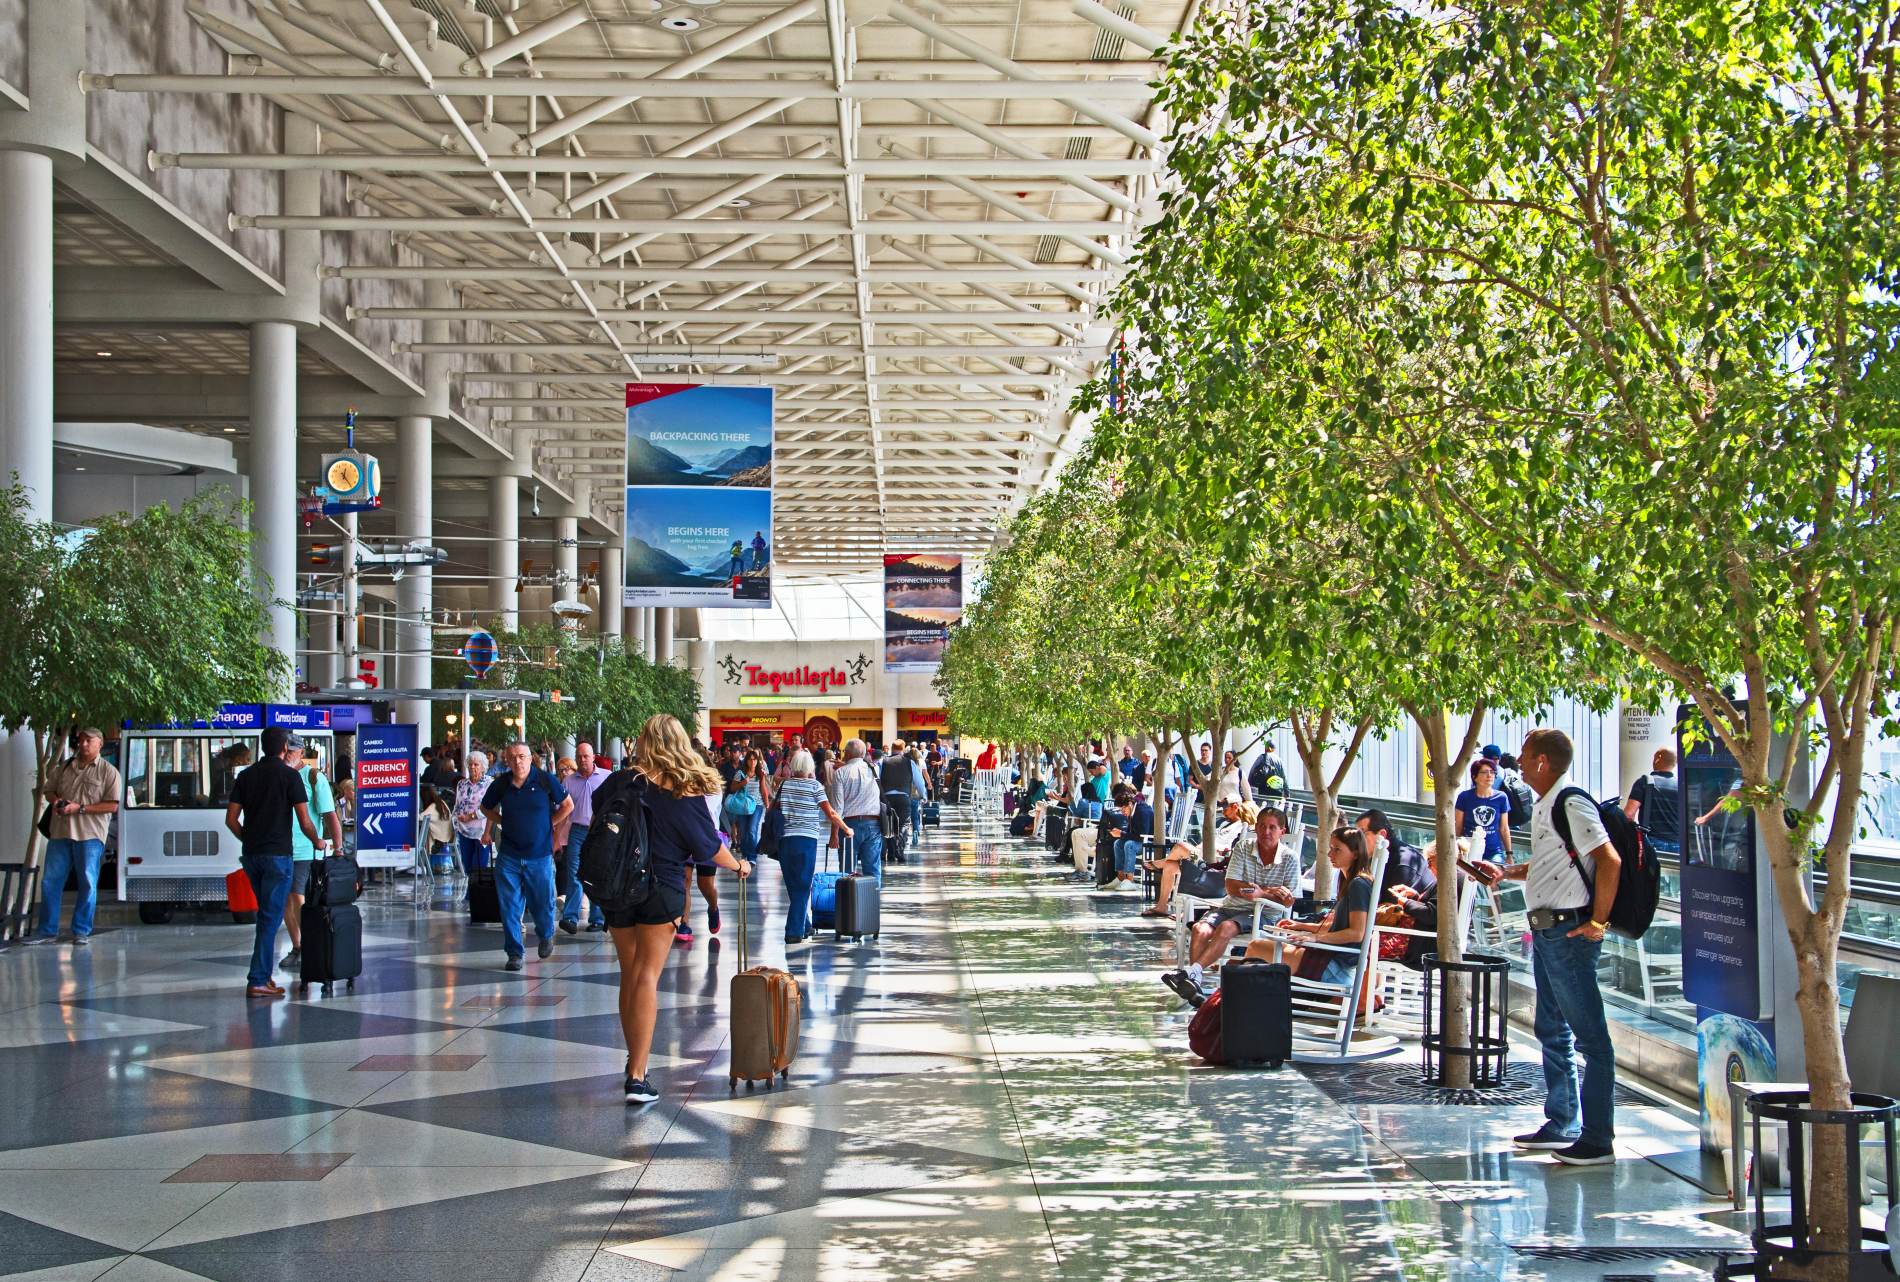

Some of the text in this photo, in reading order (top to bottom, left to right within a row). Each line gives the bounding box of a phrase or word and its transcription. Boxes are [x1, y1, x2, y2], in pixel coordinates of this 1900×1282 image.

[650, 431, 750, 442] BACKPACKING THERE
[668, 527, 729, 536] BEGINS HERE
[745, 665, 846, 693] Tequileria
[275, 711, 291, 726] Currency
[292, 712, 307, 726] Exchange
[362, 763, 407, 772] CURRENCY
[362, 776, 407, 785] EXCHANGE
[1691, 888, 1744, 908] Discover how upgrading
[1703, 930, 1735, 944] improves your
[1695, 948, 1718, 962] passenger
